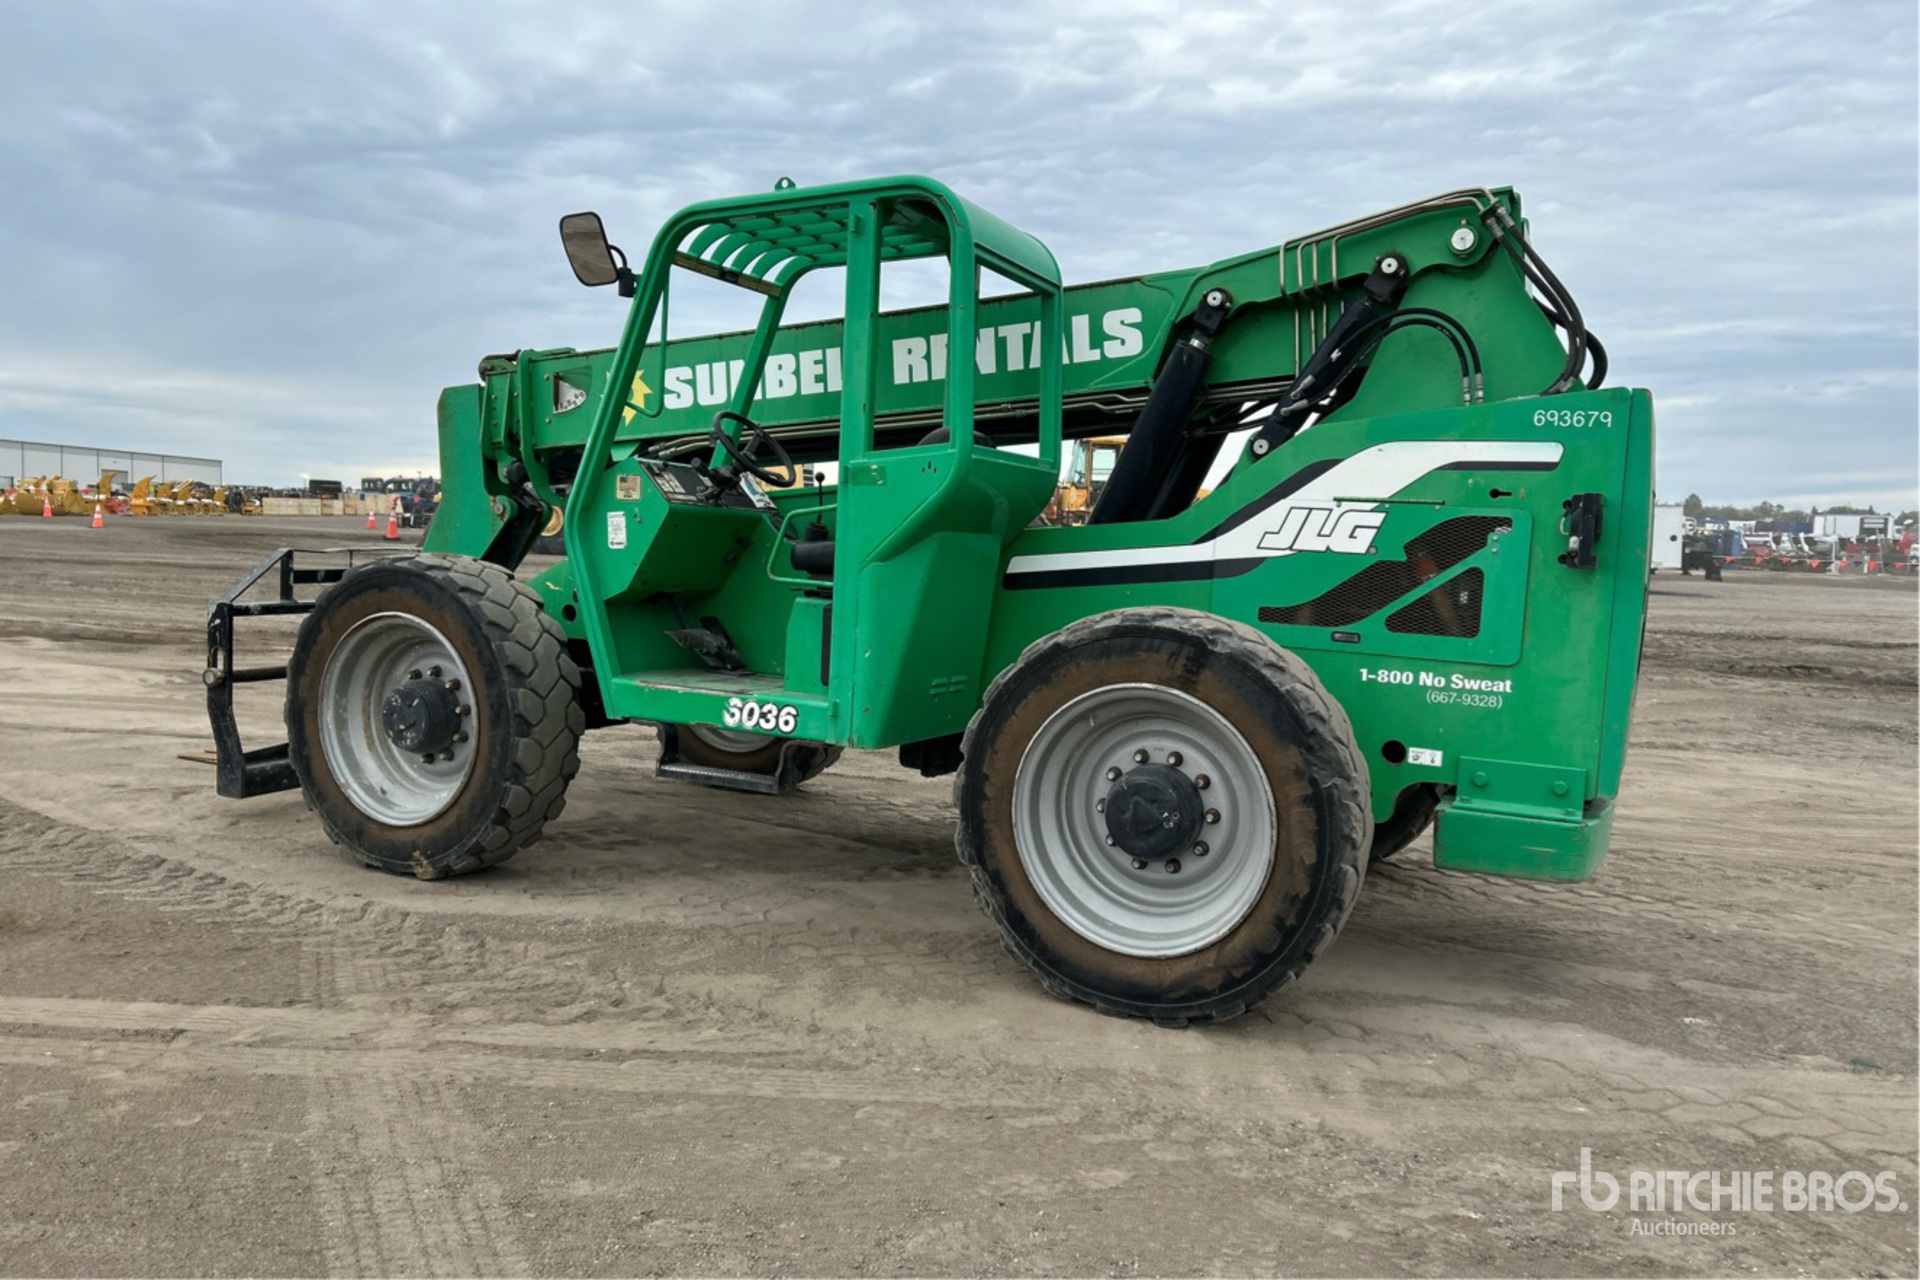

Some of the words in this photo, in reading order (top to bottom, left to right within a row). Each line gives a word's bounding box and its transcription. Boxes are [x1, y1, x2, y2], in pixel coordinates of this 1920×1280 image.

[1533, 409, 1612, 428] 693679
[1256, 506, 1389, 556] JLG
[1359, 668, 1414, 685] 1-800
[1418, 671, 1446, 688] No
[1450, 673, 1513, 693] Sweat
[1426, 689, 1503, 710] (667-9328)
